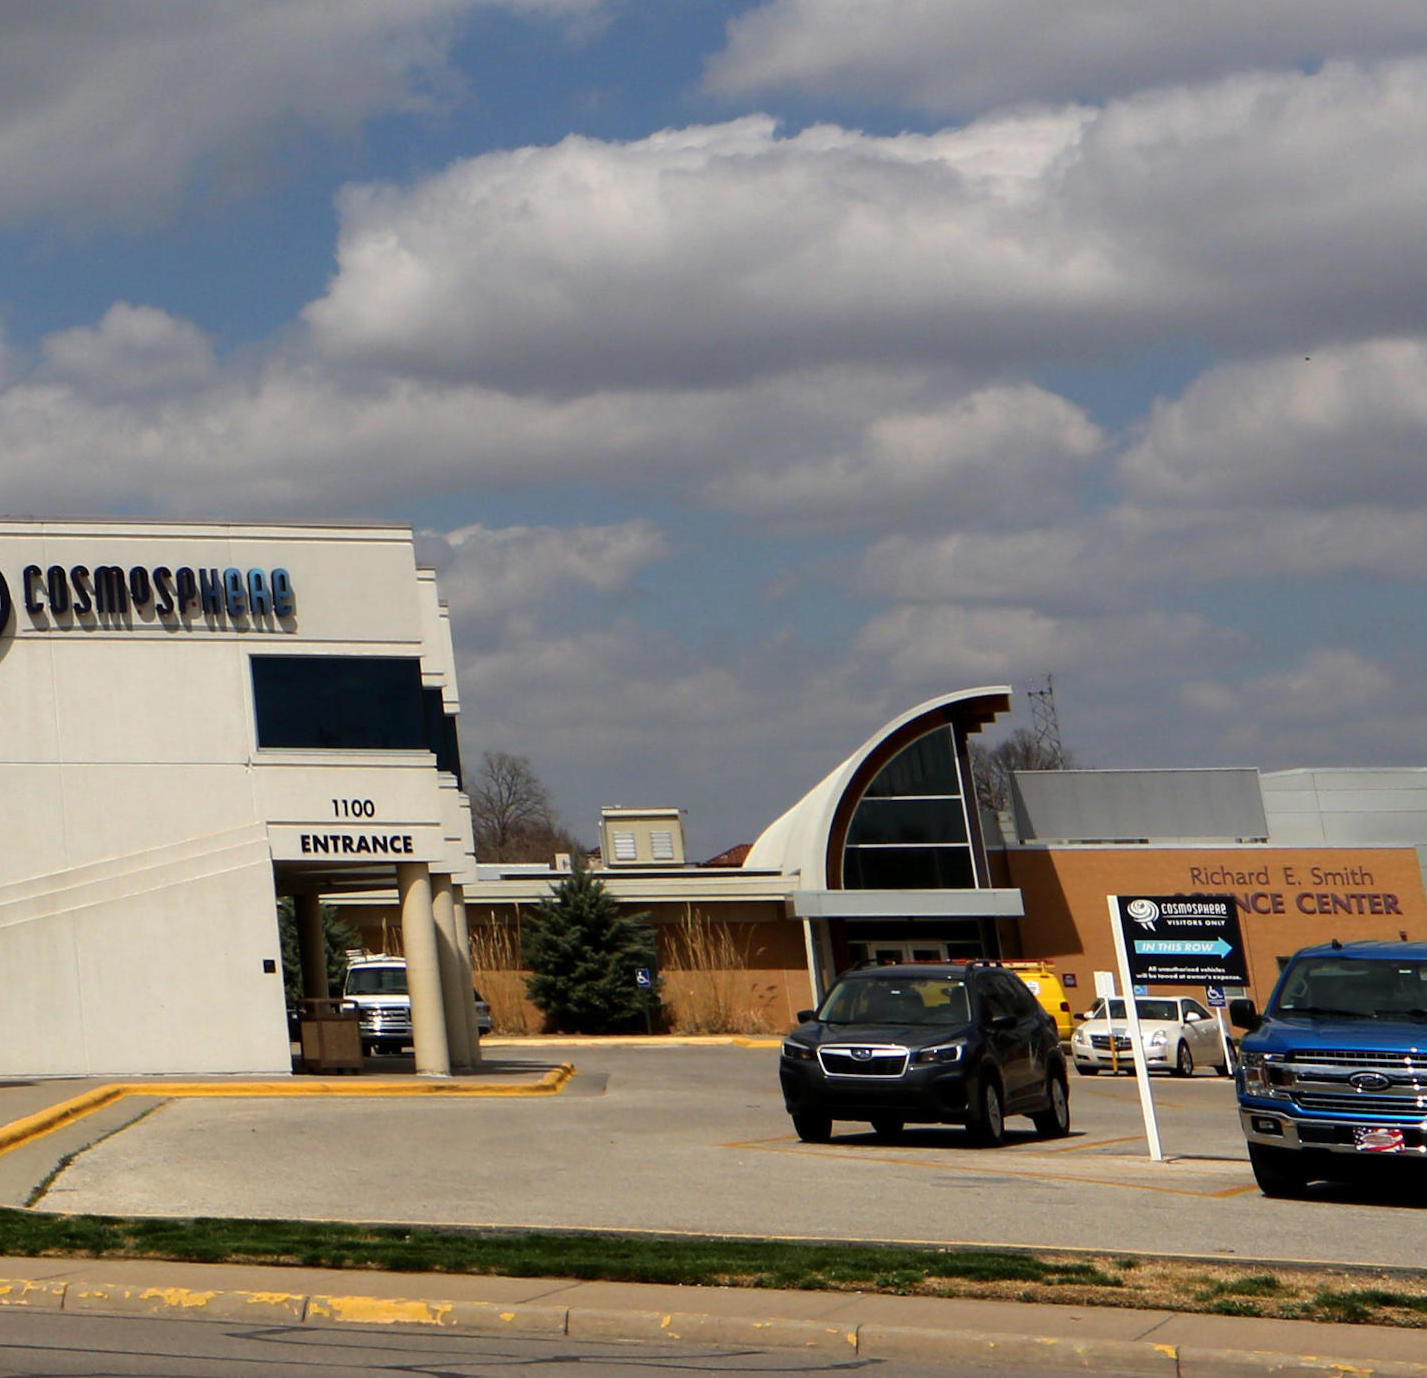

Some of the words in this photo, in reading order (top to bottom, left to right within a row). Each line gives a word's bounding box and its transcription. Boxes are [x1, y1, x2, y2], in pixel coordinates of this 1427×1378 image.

[23, 564, 295, 618] COSMOSPHERE
[331, 799, 375, 818] 1100
[300, 834, 414, 854] ENTRANCE
[1190, 866, 1271, 886] Richard
[1284, 867, 1302, 886] E.
[1311, 866, 1375, 886] Smith
[1160, 903, 1227, 915] COSMOSPHERE
[1296, 892, 1404, 915] CENTER
[1142, 942, 1157, 952] IN
[1158, 942, 1182, 952] THIS
[1184, 942, 1214, 952] ROW
